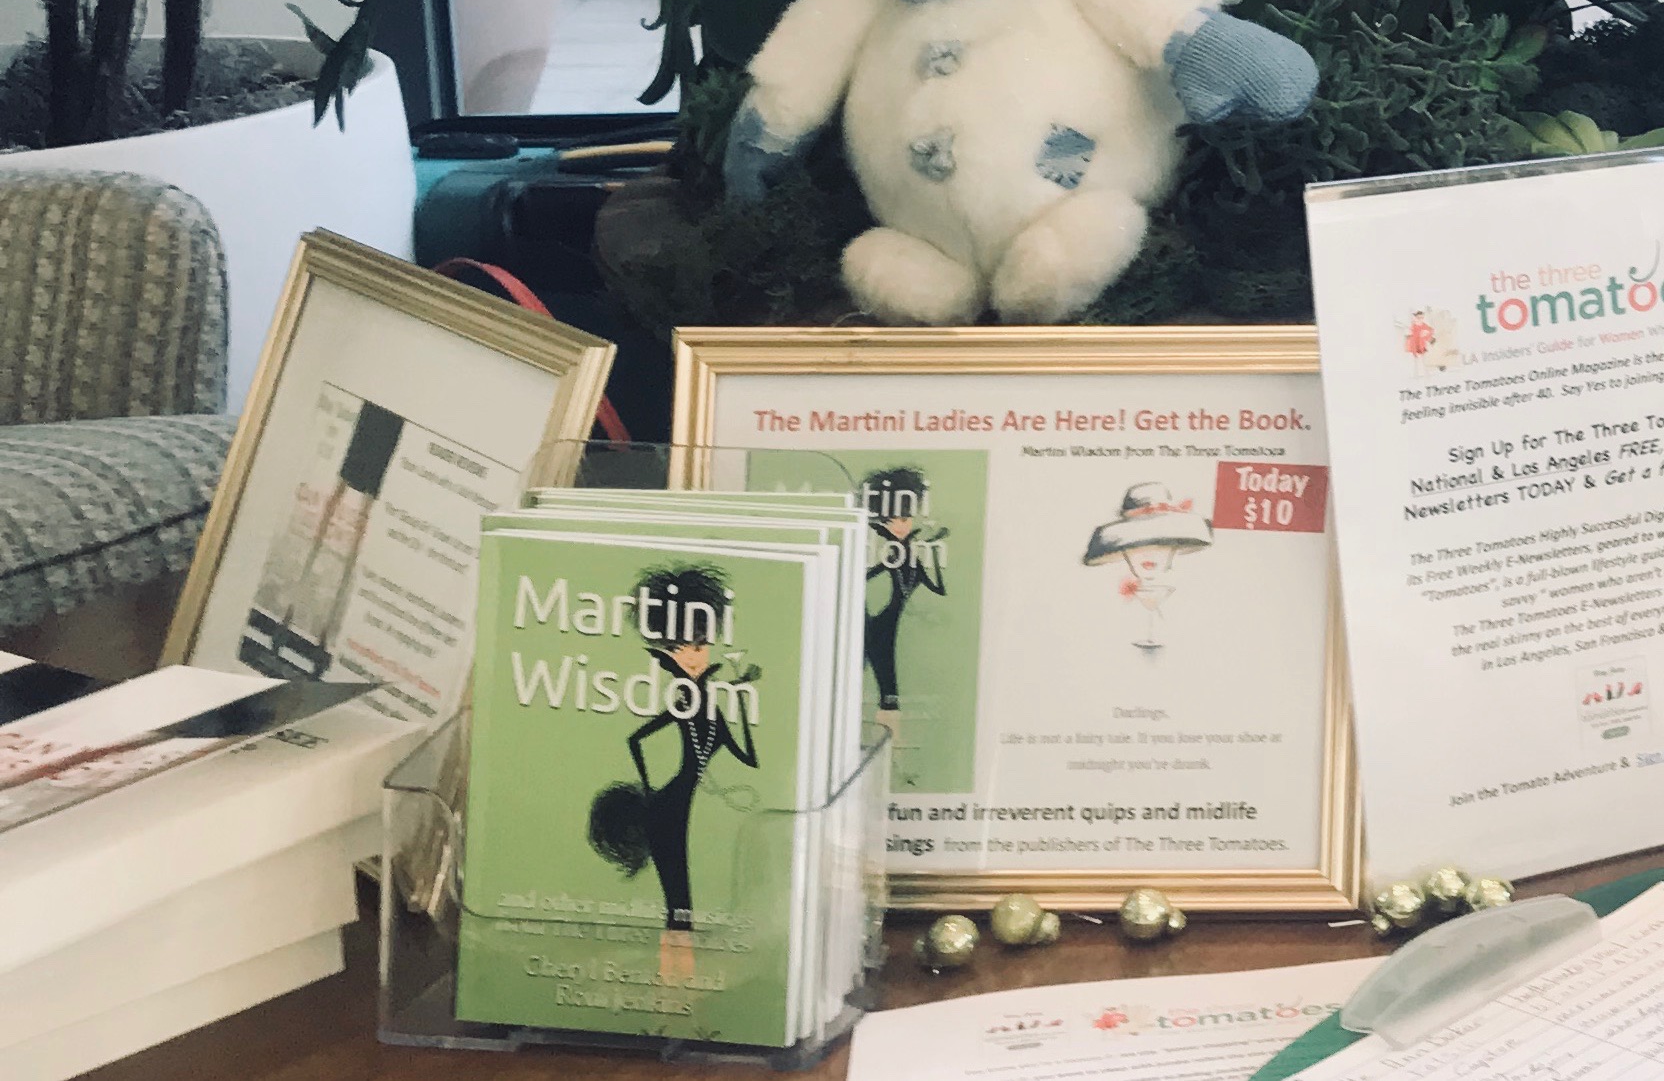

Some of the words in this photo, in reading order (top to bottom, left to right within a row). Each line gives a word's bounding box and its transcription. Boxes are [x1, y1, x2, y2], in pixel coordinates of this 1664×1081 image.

[1490, 270, 1531, 293] the
[1537, 263, 1602, 287] three
[1536, 338, 1574, 354] Guide
[1577, 335, 1595, 348] for
[1598, 329, 1644, 345] Women
[1399, 389, 1422, 400] The
[1425, 384, 1461, 397] Three
[1464, 374, 1525, 391] Tomatoes
[1527, 367, 1568, 381] Online
[1571, 358, 1630, 374] Magazine
[1632, 353, 1643, 365] is
[1644, 352, 1664, 363] the
[1400, 406, 1445, 424] feeling
[1449, 396, 1500, 413] invisible
[1502, 391, 1533, 407] after
[1561, 384, 1583, 396] Say
[1586, 381, 1606, 391] Yes
[1608, 378, 1622, 388] to
[1623, 371, 1664, 389] joining
[753, 409, 801, 432] The
[809, 410, 905, 432] Martini
[914, 409, 993, 432] Ladies
[1001, 410, 1046, 431] Are
[1055, 409, 1125, 431] Here!
[1134, 410, 1180, 431] Get
[1187, 408, 1230, 431] the
[1239, 408, 1312, 431] Book.
[1022, 446, 1067, 457] Martini
[1071, 446, 1121, 457] Wisdom
[1125, 446, 1154, 457] from
[1158, 445, 1182, 457] The
[1184, 445, 1221, 457] Three
[1224, 445, 1286, 457] Tomatoes
[1448, 446, 1483, 462] Sign
[1492, 440, 1513, 455] Up
[1521, 434, 1547, 450] for
[1553, 430, 1584, 444] The
[1591, 421, 1639, 438] Three
[1235, 466, 1310, 498] Today
[1411, 468, 1482, 493] National
[1491, 465, 1504, 480] &
[1512, 462, 1539, 477] Los
[1547, 450, 1610, 469] Angeles
[864, 482, 933, 518] tini
[1404, 491, 1509, 520] Newsletters
[1516, 477, 1574, 499] TODAY
[1583, 474, 1595, 489] &
[1604, 468, 1635, 485] Get
[1641, 467, 1651, 479] a
[1245, 499, 1294, 527] $10
[1410, 553, 1433, 565] The
[1436, 546, 1472, 560] Three
[1475, 534, 1536, 553] Tomatoes
[1539, 526, 1577, 542] Highly
[1580, 513, 1641, 534] Successful
[1425, 569, 1453, 582] Free
[1455, 558, 1503, 576] Weekly
[1596, 532, 1638, 553] geared
[1641, 532, 1654, 542] to
[1502, 576, 1513, 588] is
[1514, 575, 1524, 585] a
[1591, 552, 1638, 572] lifestyle
[1596, 576, 1623, 589] who
[514, 575, 735, 646] Martini
[1452, 624, 1476, 636] The
[1478, 616, 1514, 631] Three
[1517, 604, 1578, 623] Tomatoes
[1451, 644, 1472, 656] the
[1475, 636, 1500, 651] real
[1502, 631, 1542, 646] skinny
[1544, 627, 1561, 638] on
[1563, 621, 1584, 634] the
[1586, 615, 1613, 630] best
[1614, 610, 1629, 626] of
[1496, 655, 1517, 668] Los
[1574, 639, 1597, 652] San
[1599, 627, 1655, 645] Francisco
[512, 652, 759, 725] Wisdom
[1477, 788, 1499, 800] the
[1500, 776, 1550, 794] Tomato
[1552, 761, 1617, 784] Adventure
[1620, 756, 1630, 768] &
[887, 802, 922, 821] fun
[928, 803, 967, 821] and
[973, 803, 1075, 821] irreverent
[1080, 803, 1136, 824] quips
[1142, 803, 1180, 820] and
[1186, 802, 1257, 820] midlife
[886, 834, 934, 856] sings
[943, 837, 981, 852] from
[987, 838, 1014, 852] the
[1016, 837, 1099, 855] publishers
[1103, 836, 1122, 852] of
[1124, 837, 1154, 852] The
[1158, 836, 1204, 851] Three
